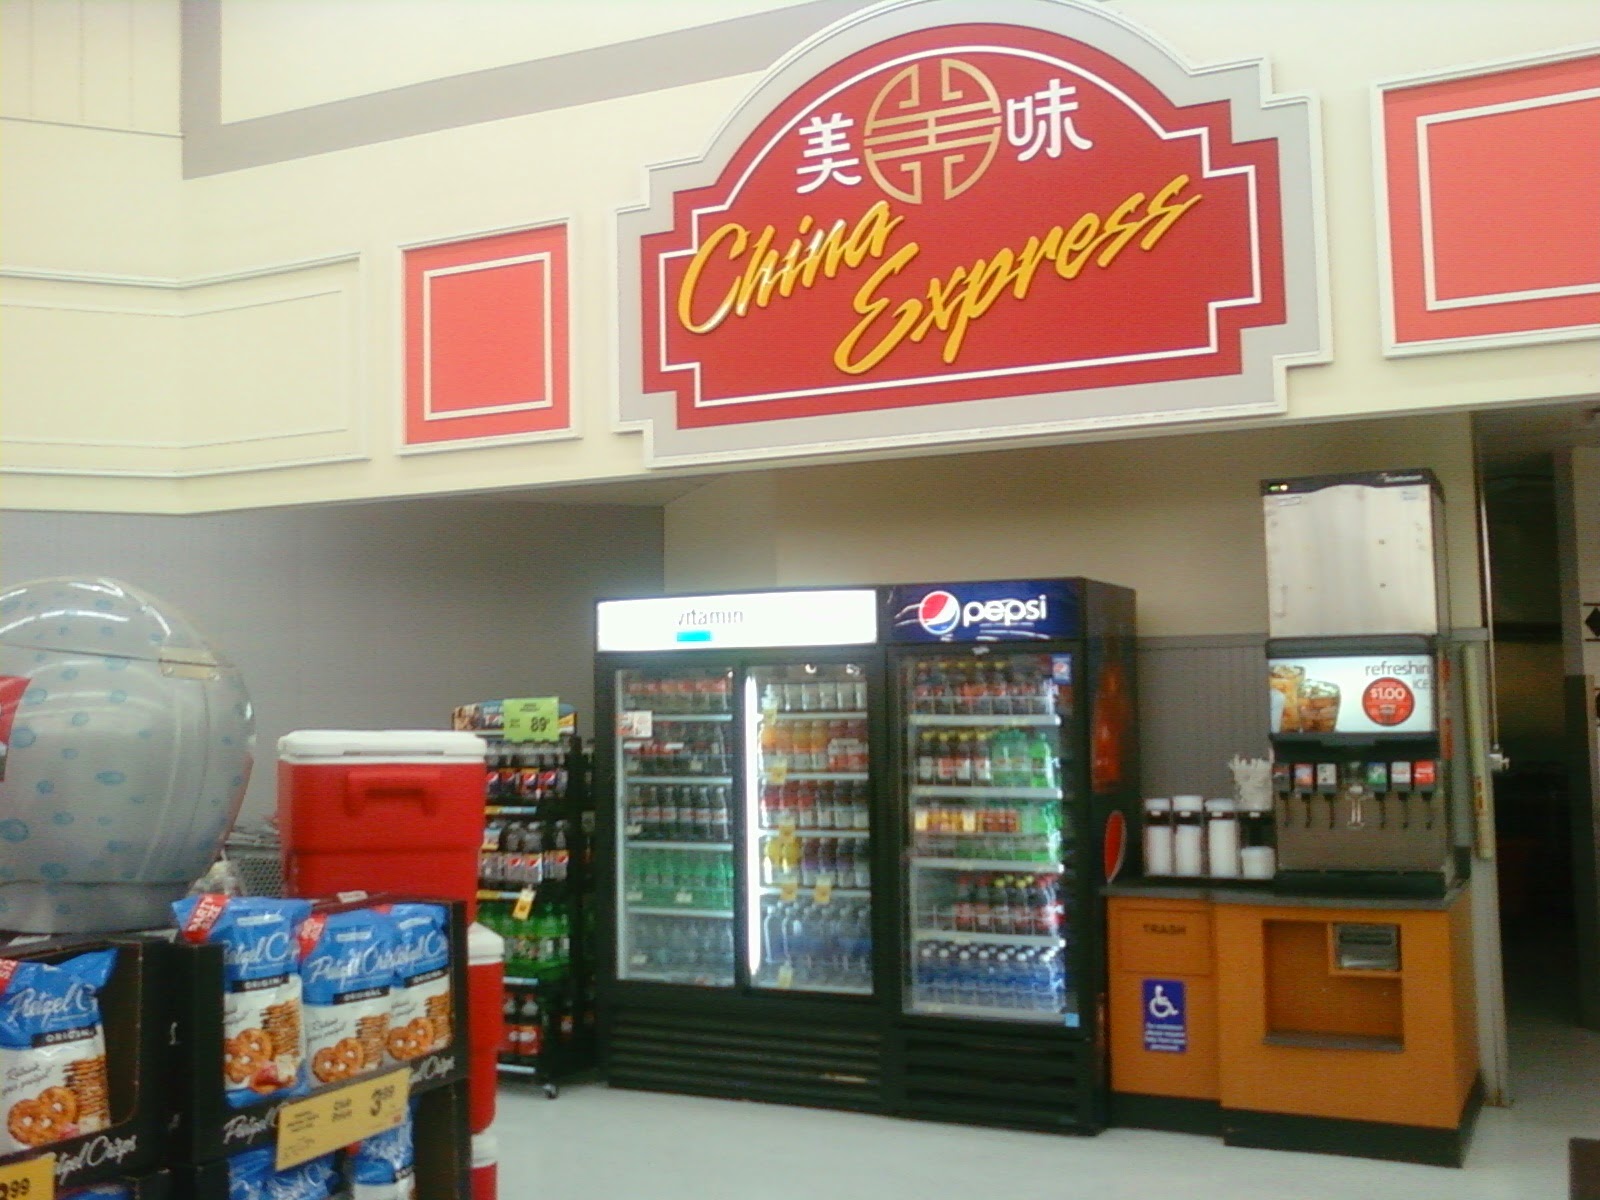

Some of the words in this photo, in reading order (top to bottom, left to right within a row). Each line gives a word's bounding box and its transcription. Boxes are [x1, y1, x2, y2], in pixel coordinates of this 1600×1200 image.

[797, 112, 862, 193] 美
[1006, 77, 1092, 162] 味
[678, 199, 905, 334] China
[834, 173, 1202, 374] Express
[678, 608, 744, 626] vitamin
[962, 594, 1047, 627] pepsi
